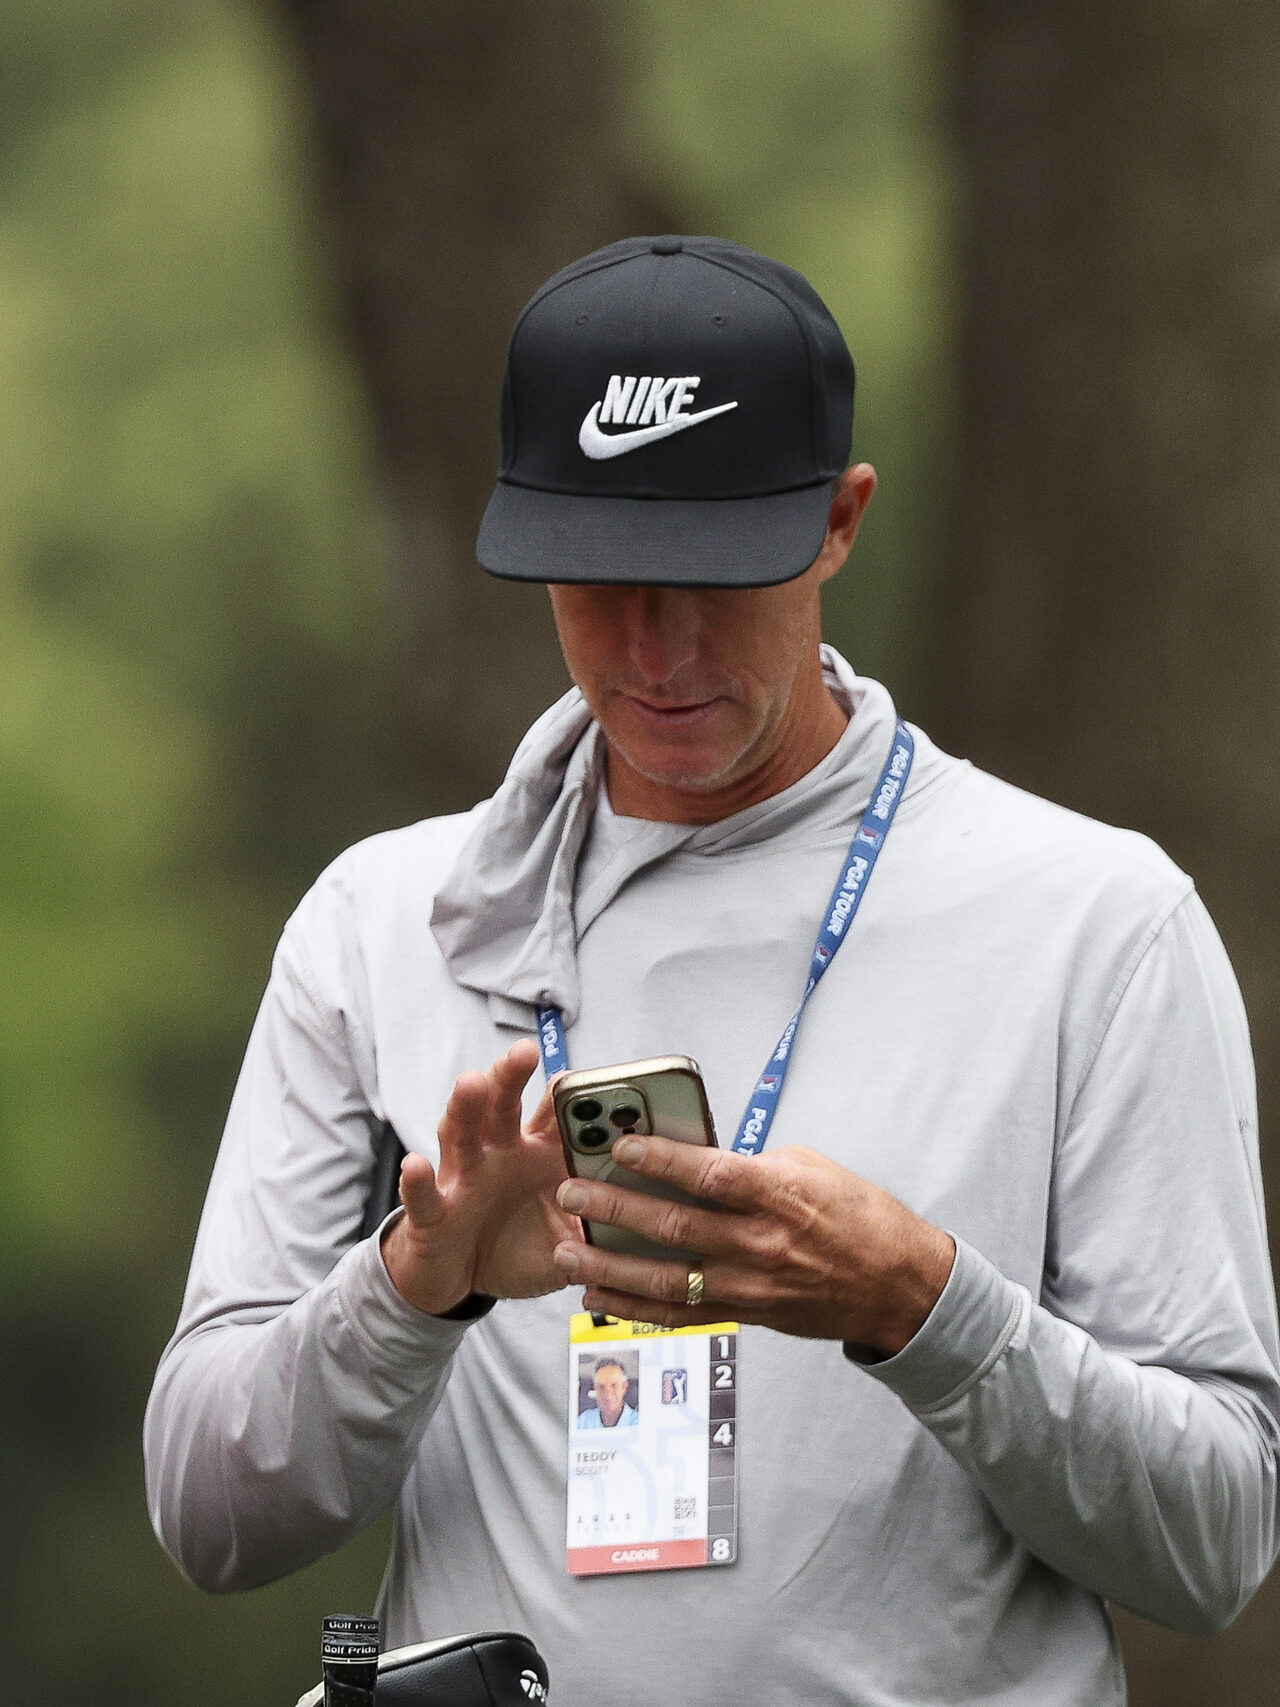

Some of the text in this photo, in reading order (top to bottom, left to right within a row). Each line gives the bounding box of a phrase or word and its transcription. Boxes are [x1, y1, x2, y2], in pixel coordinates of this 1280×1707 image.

[599, 375, 701, 424] NIKE
[871, 744, 910, 820] PGA TOUR
[826, 855, 869, 936] PGA TOUR
[541, 1018, 560, 1058] PGA
[740, 1107, 767, 1145] PGA
[717, 1335, 729, 1359] 1
[714, 1364, 733, 1389] 2
[713, 1422, 733, 1446] 4
[611, 1548, 659, 1564] CADDIE
[712, 1538, 730, 1561] 8
[324, 1645, 377, 1654] Golf Pride
